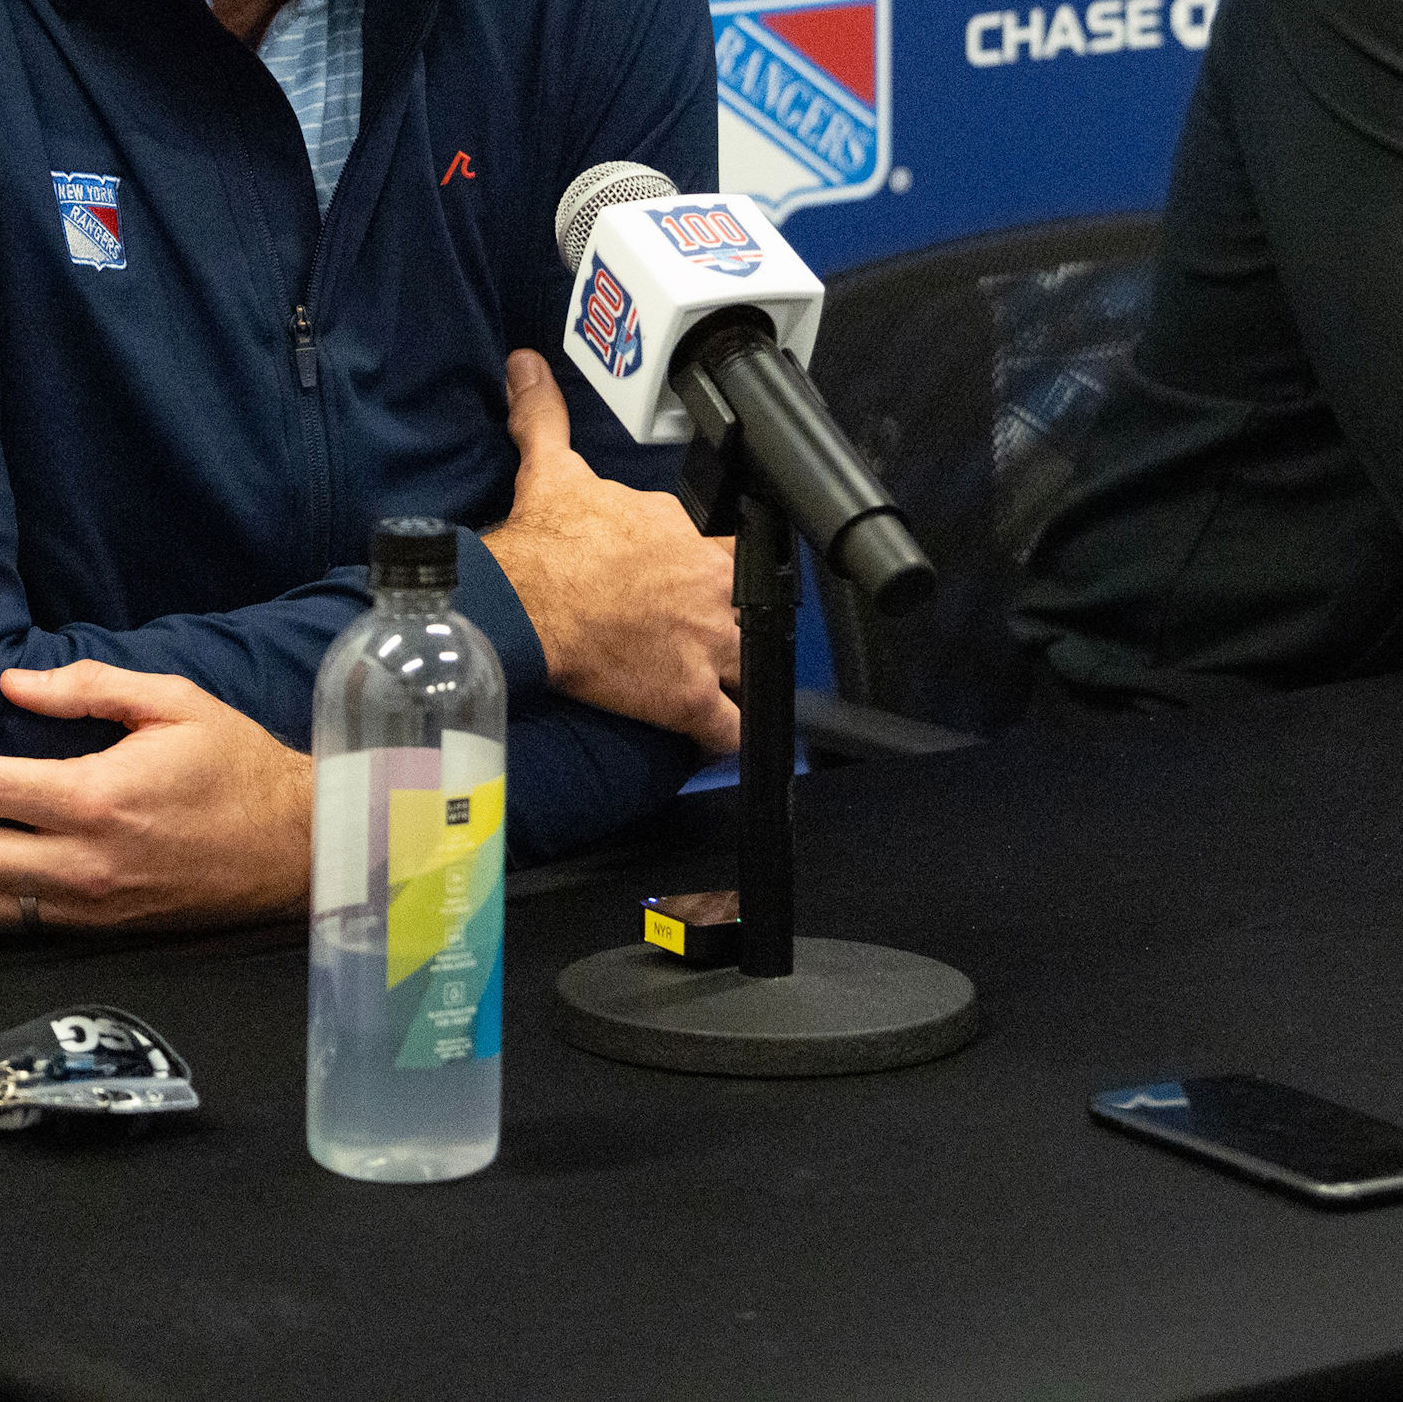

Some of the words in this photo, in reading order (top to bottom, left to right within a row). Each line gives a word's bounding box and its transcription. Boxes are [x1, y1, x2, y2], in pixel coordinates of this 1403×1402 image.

[58, 183, 84, 200] NEW
[87, 185, 115, 203] YORK
[70, 205, 121, 260] RANGERS
[662, 211, 748, 250] 100
[583, 269, 625, 364] 100
[653, 921, 672, 940] NYR
